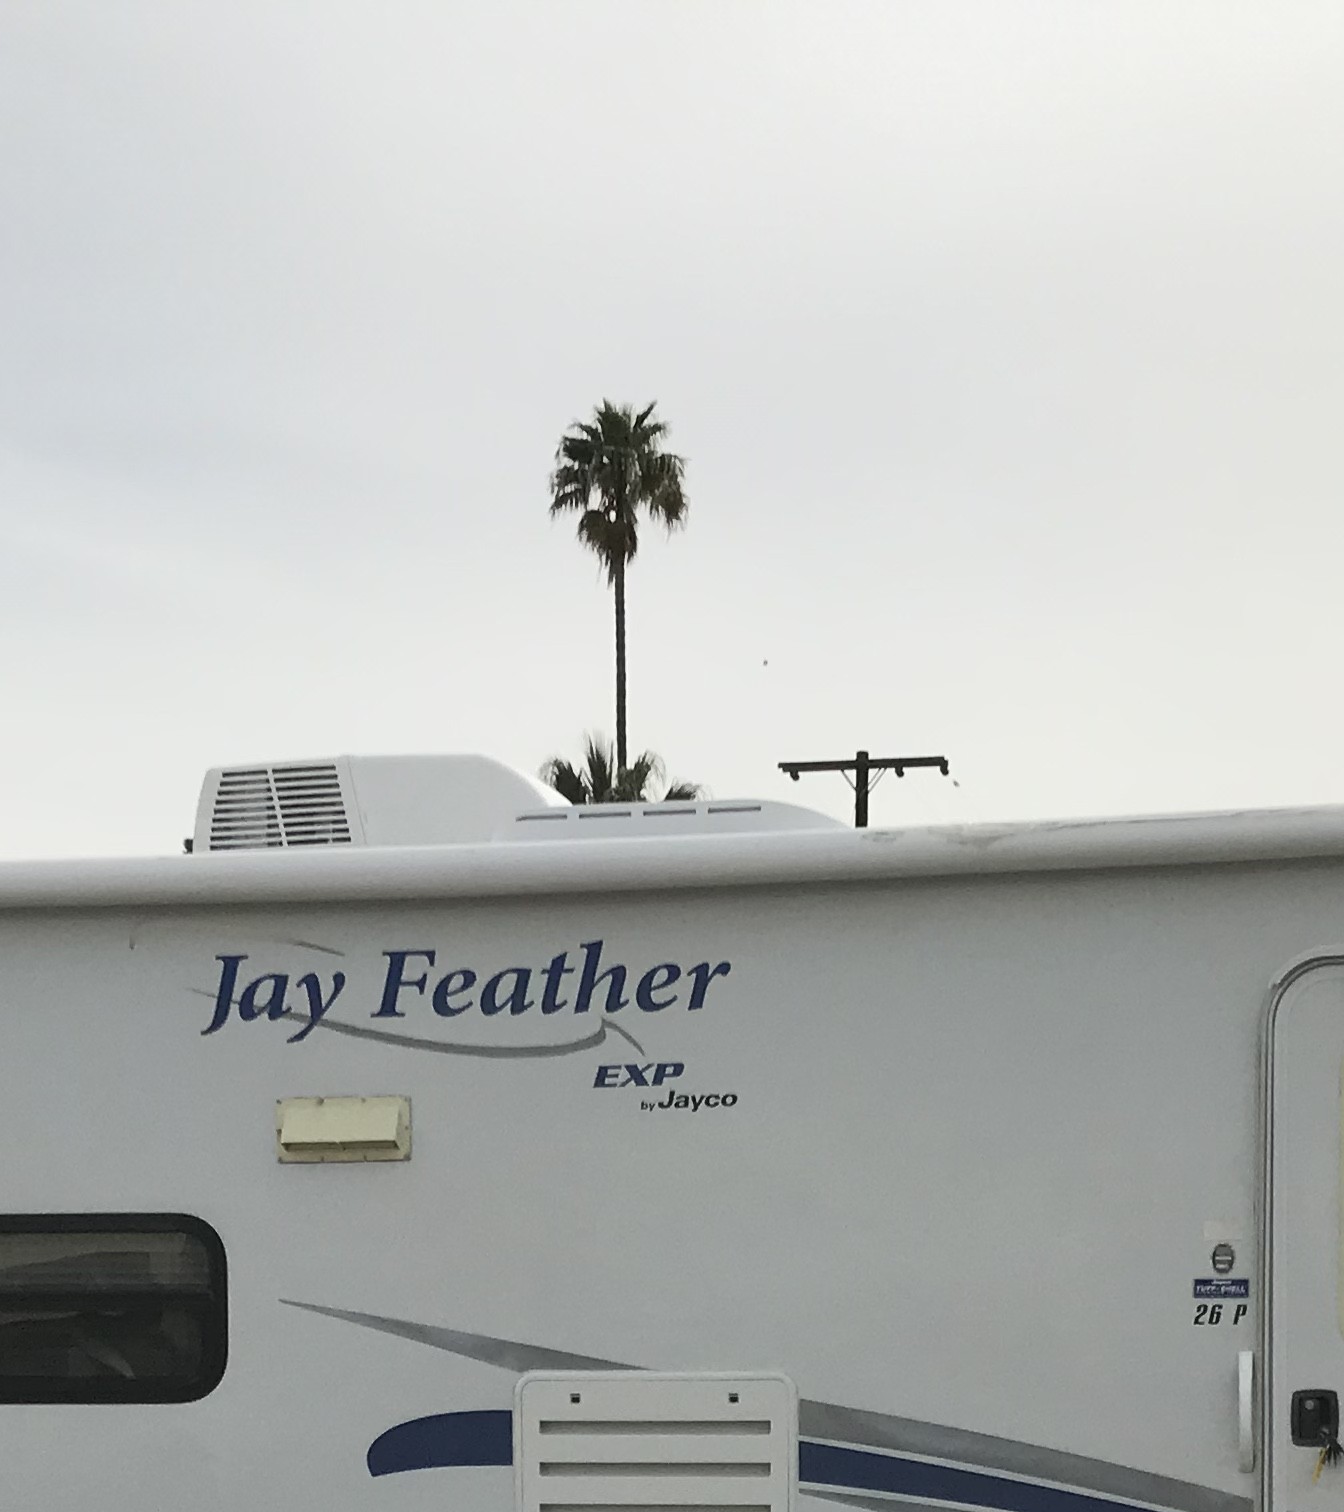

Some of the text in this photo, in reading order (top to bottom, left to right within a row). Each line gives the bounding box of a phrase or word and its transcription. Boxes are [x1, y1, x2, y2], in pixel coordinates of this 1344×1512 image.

[200, 939, 732, 1044] Jay Feather
[592, 1062, 685, 1089] EXP
[640, 1089, 738, 1112] by Jayco
[1193, 1303, 1248, 1326] 26 P
